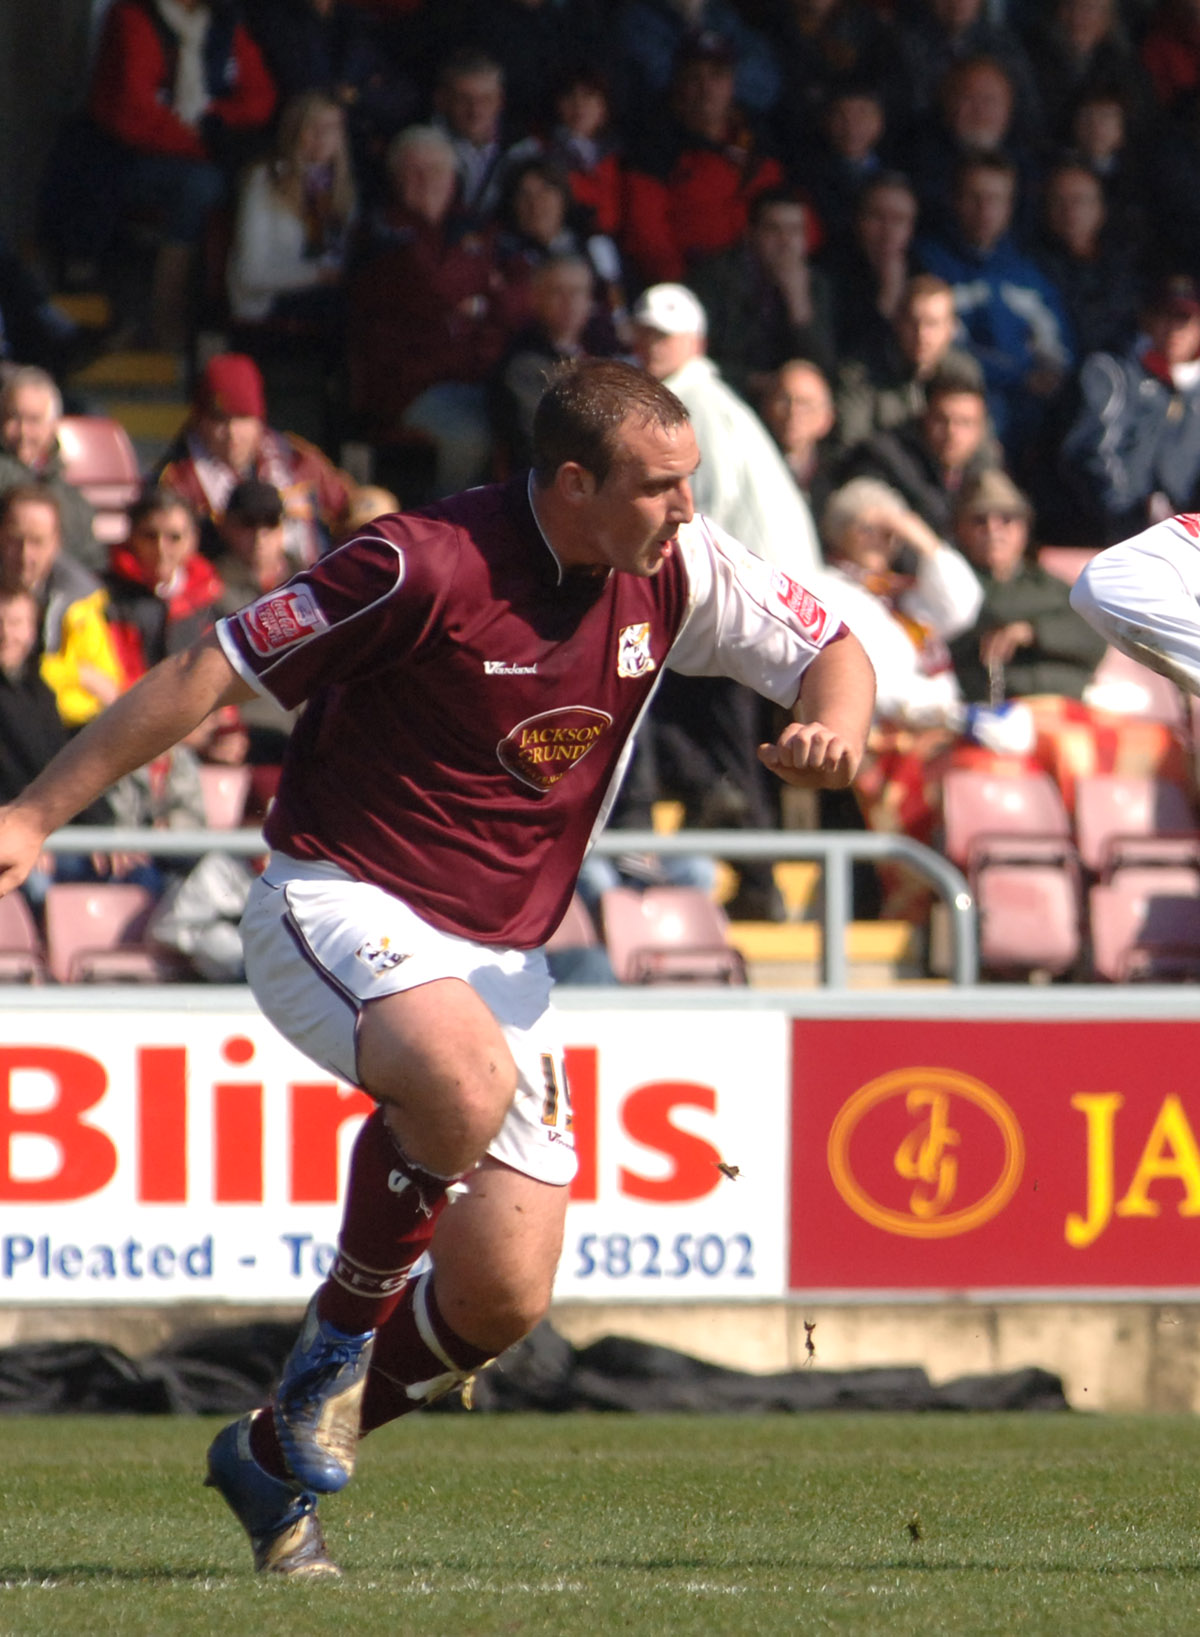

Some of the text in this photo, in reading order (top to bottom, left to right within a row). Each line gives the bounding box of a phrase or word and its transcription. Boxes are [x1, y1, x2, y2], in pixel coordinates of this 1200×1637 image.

[519, 722, 605, 748] JACKSON
[518, 741, 592, 764] GRUND
[3, 1233, 213, 1279] Pleated
[280, 1232, 338, 1280] Te
[575, 1233, 755, 1277] 582502
